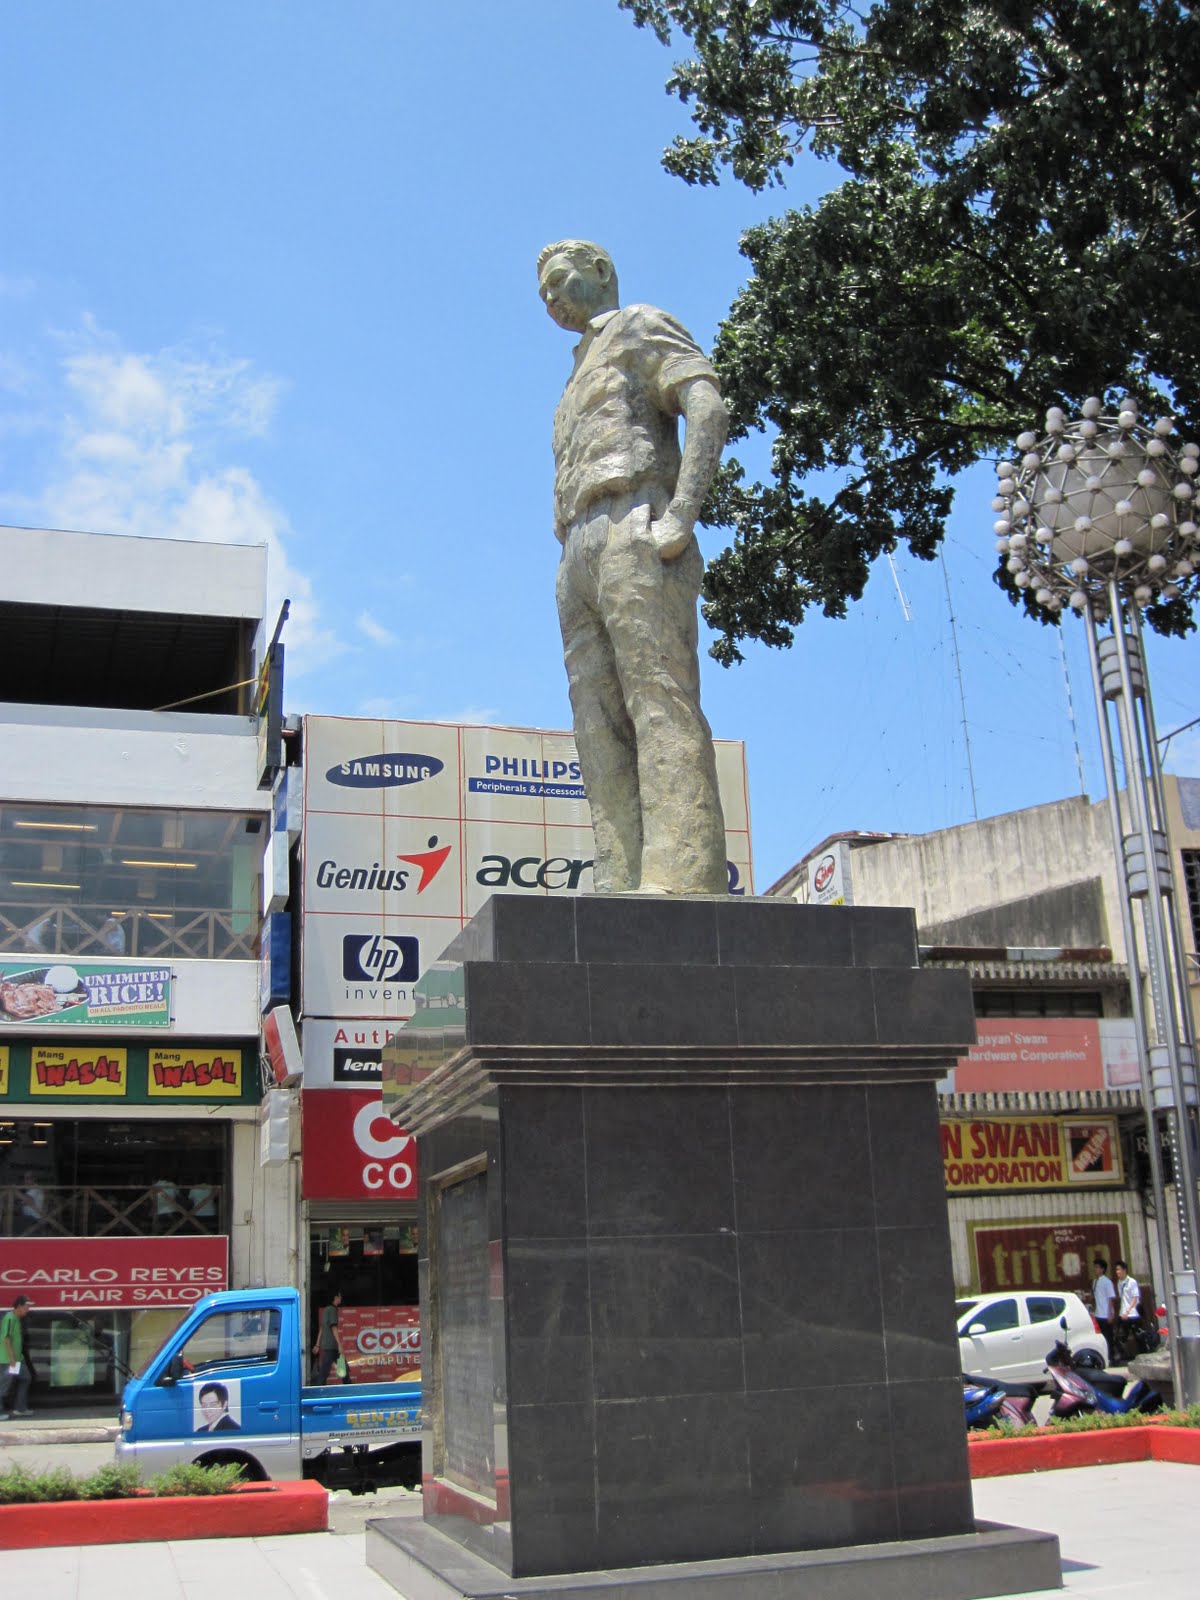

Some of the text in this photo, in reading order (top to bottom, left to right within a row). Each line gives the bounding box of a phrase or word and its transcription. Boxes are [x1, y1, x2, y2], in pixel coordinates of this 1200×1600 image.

[340, 762, 431, 780] SAMSUNG
[485, 755, 582, 780] PHILIPS
[476, 781, 586, 796] Peripherals & Accessorie
[316, 860, 410, 892] Genius
[476, 854, 594, 890] acer
[365, 935, 399, 982] hp
[85, 971, 170, 987] UNLIMITED
[89, 982, 164, 1006] RICE!
[345, 986, 416, 1000] invent
[144, 1002, 166, 1011] MEALS
[38, 1050, 64, 1060] Mang
[154, 1052, 181, 1061] Mang
[1020, 1049, 1087, 1063] Corporation
[35, 1055, 122, 1087] INASAL
[152, 1057, 237, 1088] INASAL
[970, 1121, 1060, 1159] SWANI
[945, 1160, 1062, 1186] ORPORATION
[1, 1267, 224, 1284] CARLO REYES
[60, 1289, 124, 1302] HAIR
[346, 1411, 409, 1424] BENJO
